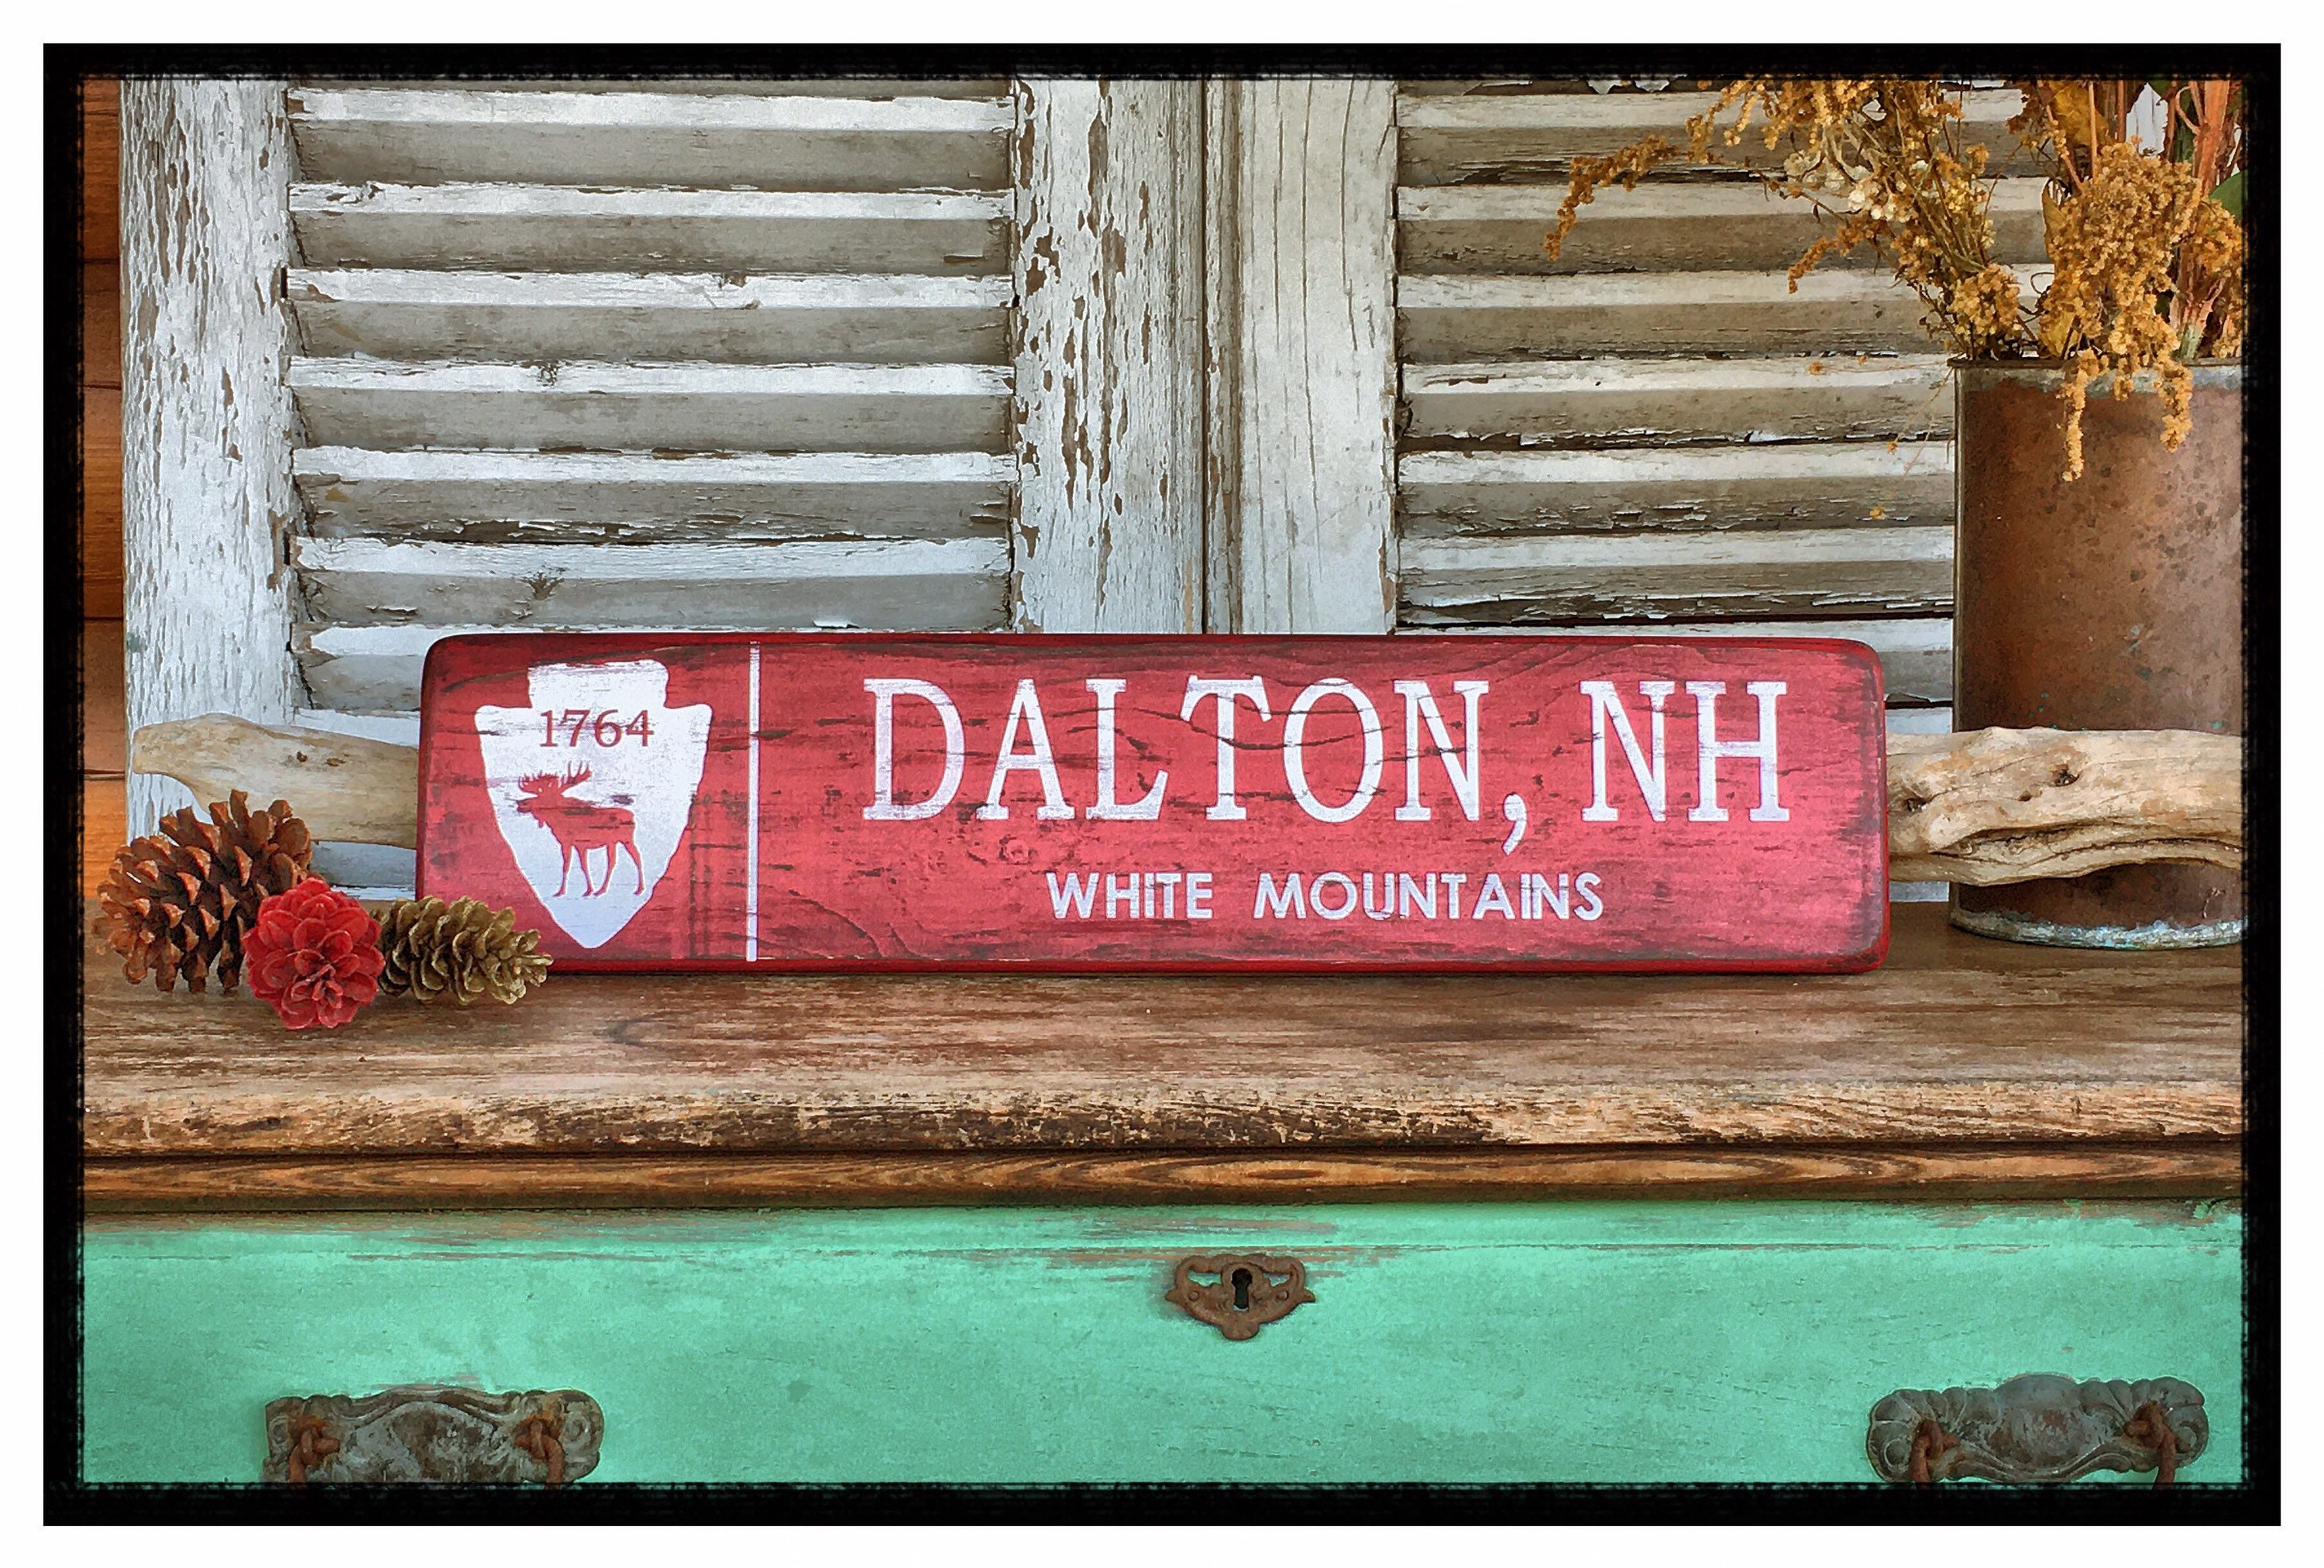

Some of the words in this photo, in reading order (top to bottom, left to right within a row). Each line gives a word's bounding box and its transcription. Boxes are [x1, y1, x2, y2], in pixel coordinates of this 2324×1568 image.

[539, 708, 654, 748] 1764
[861, 676, 1528, 856] DALTON,
[1580, 678, 1791, 823] NH
[1045, 872, 1214, 920] WHITE
[1253, 871, 1606, 922] MOUNTAINS
